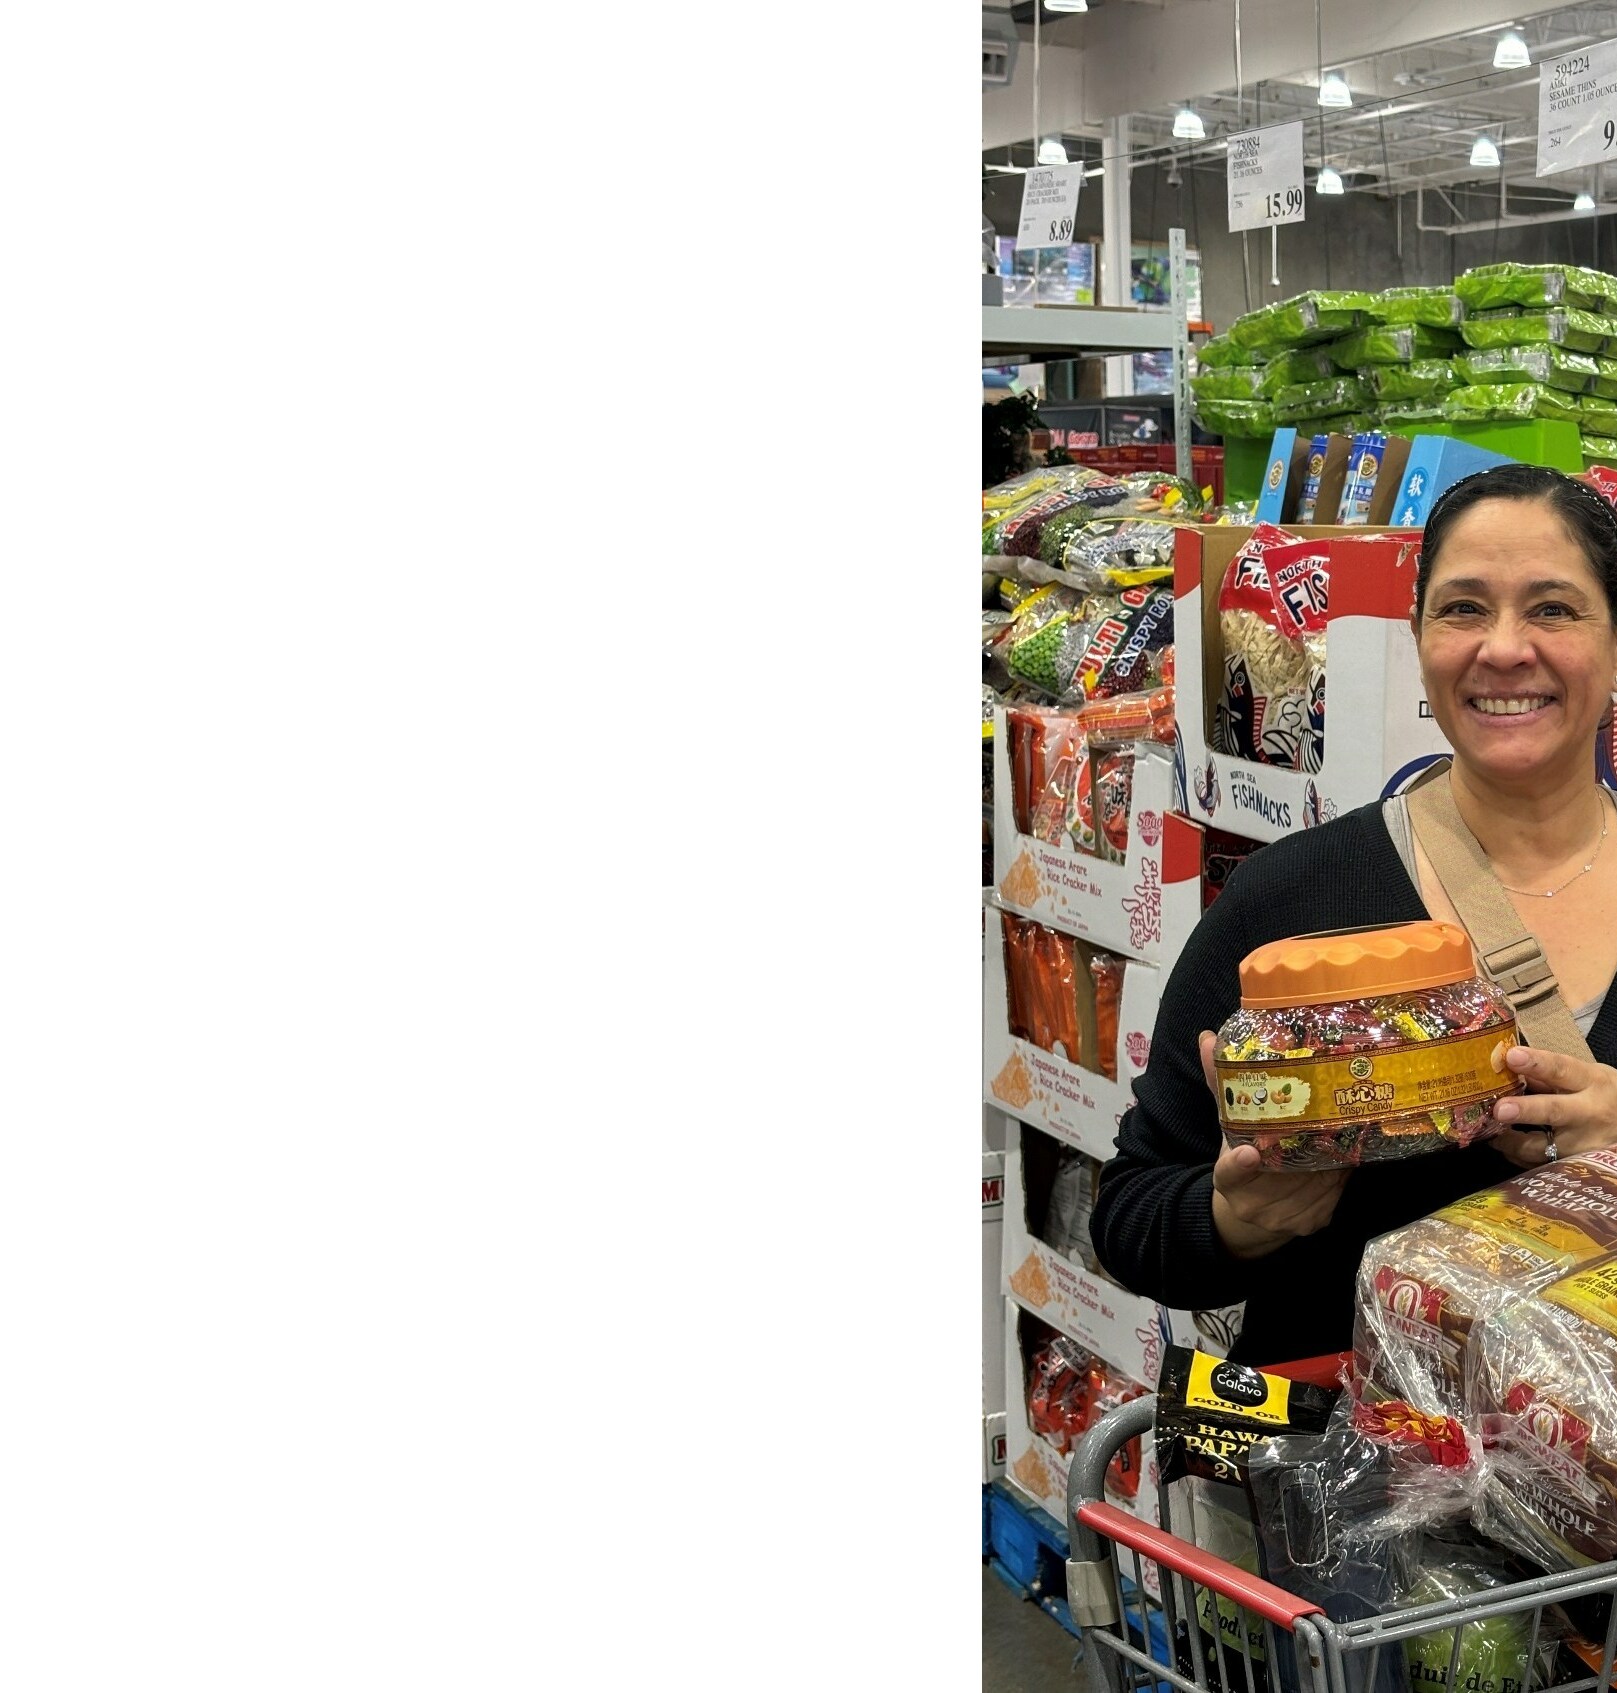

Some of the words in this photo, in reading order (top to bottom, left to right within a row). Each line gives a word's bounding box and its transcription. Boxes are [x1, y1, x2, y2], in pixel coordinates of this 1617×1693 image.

[1555, 56, 1590, 80] 594224
[1550, 86, 1576, 102] SESAME
[1577, 80, 1596, 93] THINS
[1558, 96, 1580, 110] COUNT
[1596, 84, 1617, 98] OUNCE
[1266, 189, 1302, 218] 15.99
[1049, 220, 1072, 242] 8.89
[1246, 773, 1256, 784] SEA
[1232, 784, 1292, 828] FISHNACKS
[1090, 882, 1102, 897] Mix
[1335, 1083, 1394, 1106] 酥心糖
[1340, 1104, 1366, 1116] Crispy
[1368, 1101, 1392, 1112] Candy
[1521, 1187, 1586, 1212] WHEAT
[1217, 1374, 1262, 1397] Calavo
[1193, 1397, 1244, 1412] GOLD
[1466, 1672, 1495, 1692] de
